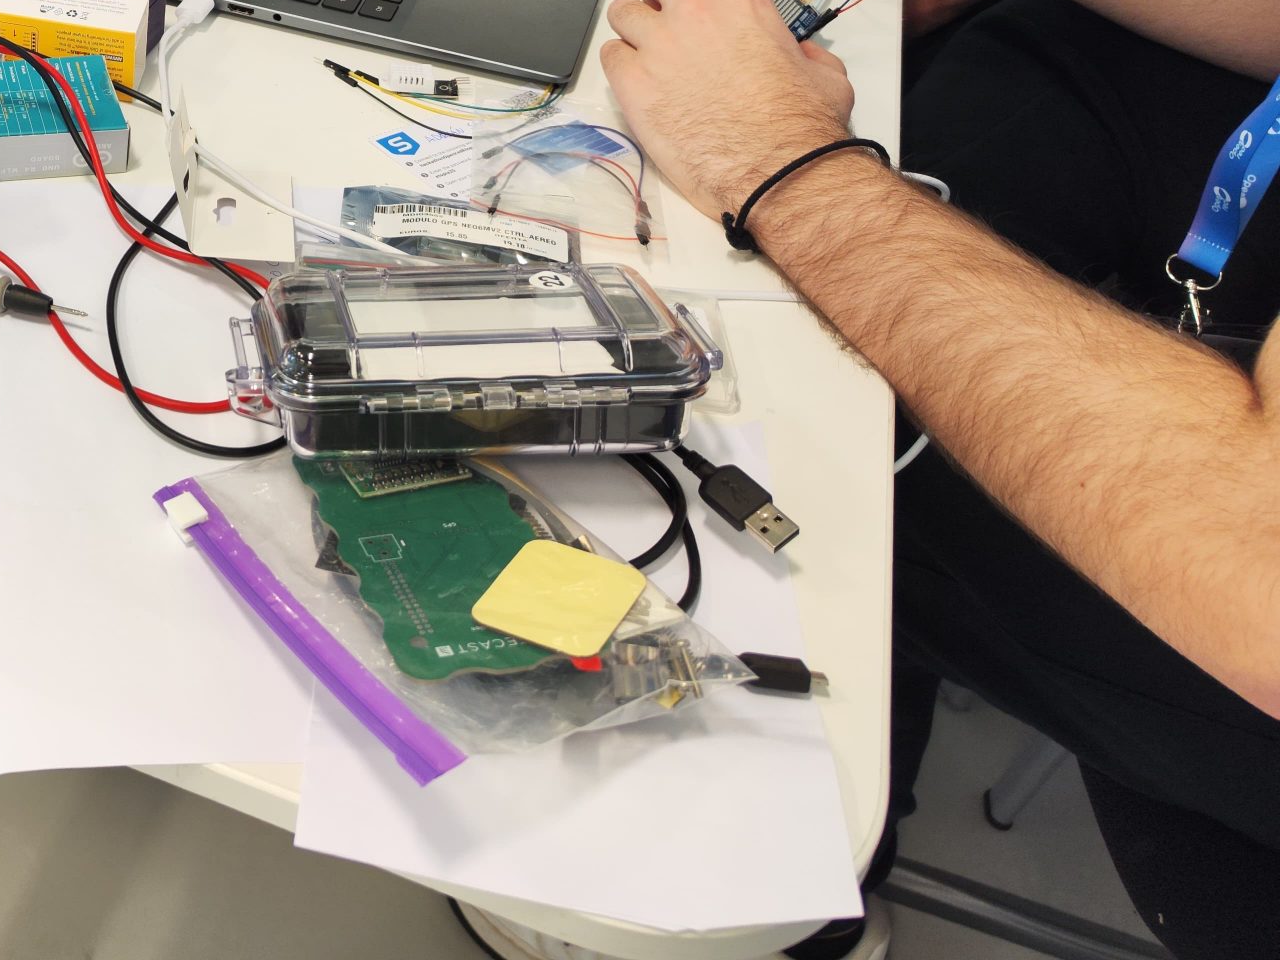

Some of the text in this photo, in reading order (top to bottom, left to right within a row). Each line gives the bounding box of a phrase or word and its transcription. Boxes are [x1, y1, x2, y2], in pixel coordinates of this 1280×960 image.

[441, 219, 458, 227] GPS
[538, 275, 565, 287] 22
[458, 638, 518, 654] ECAST
